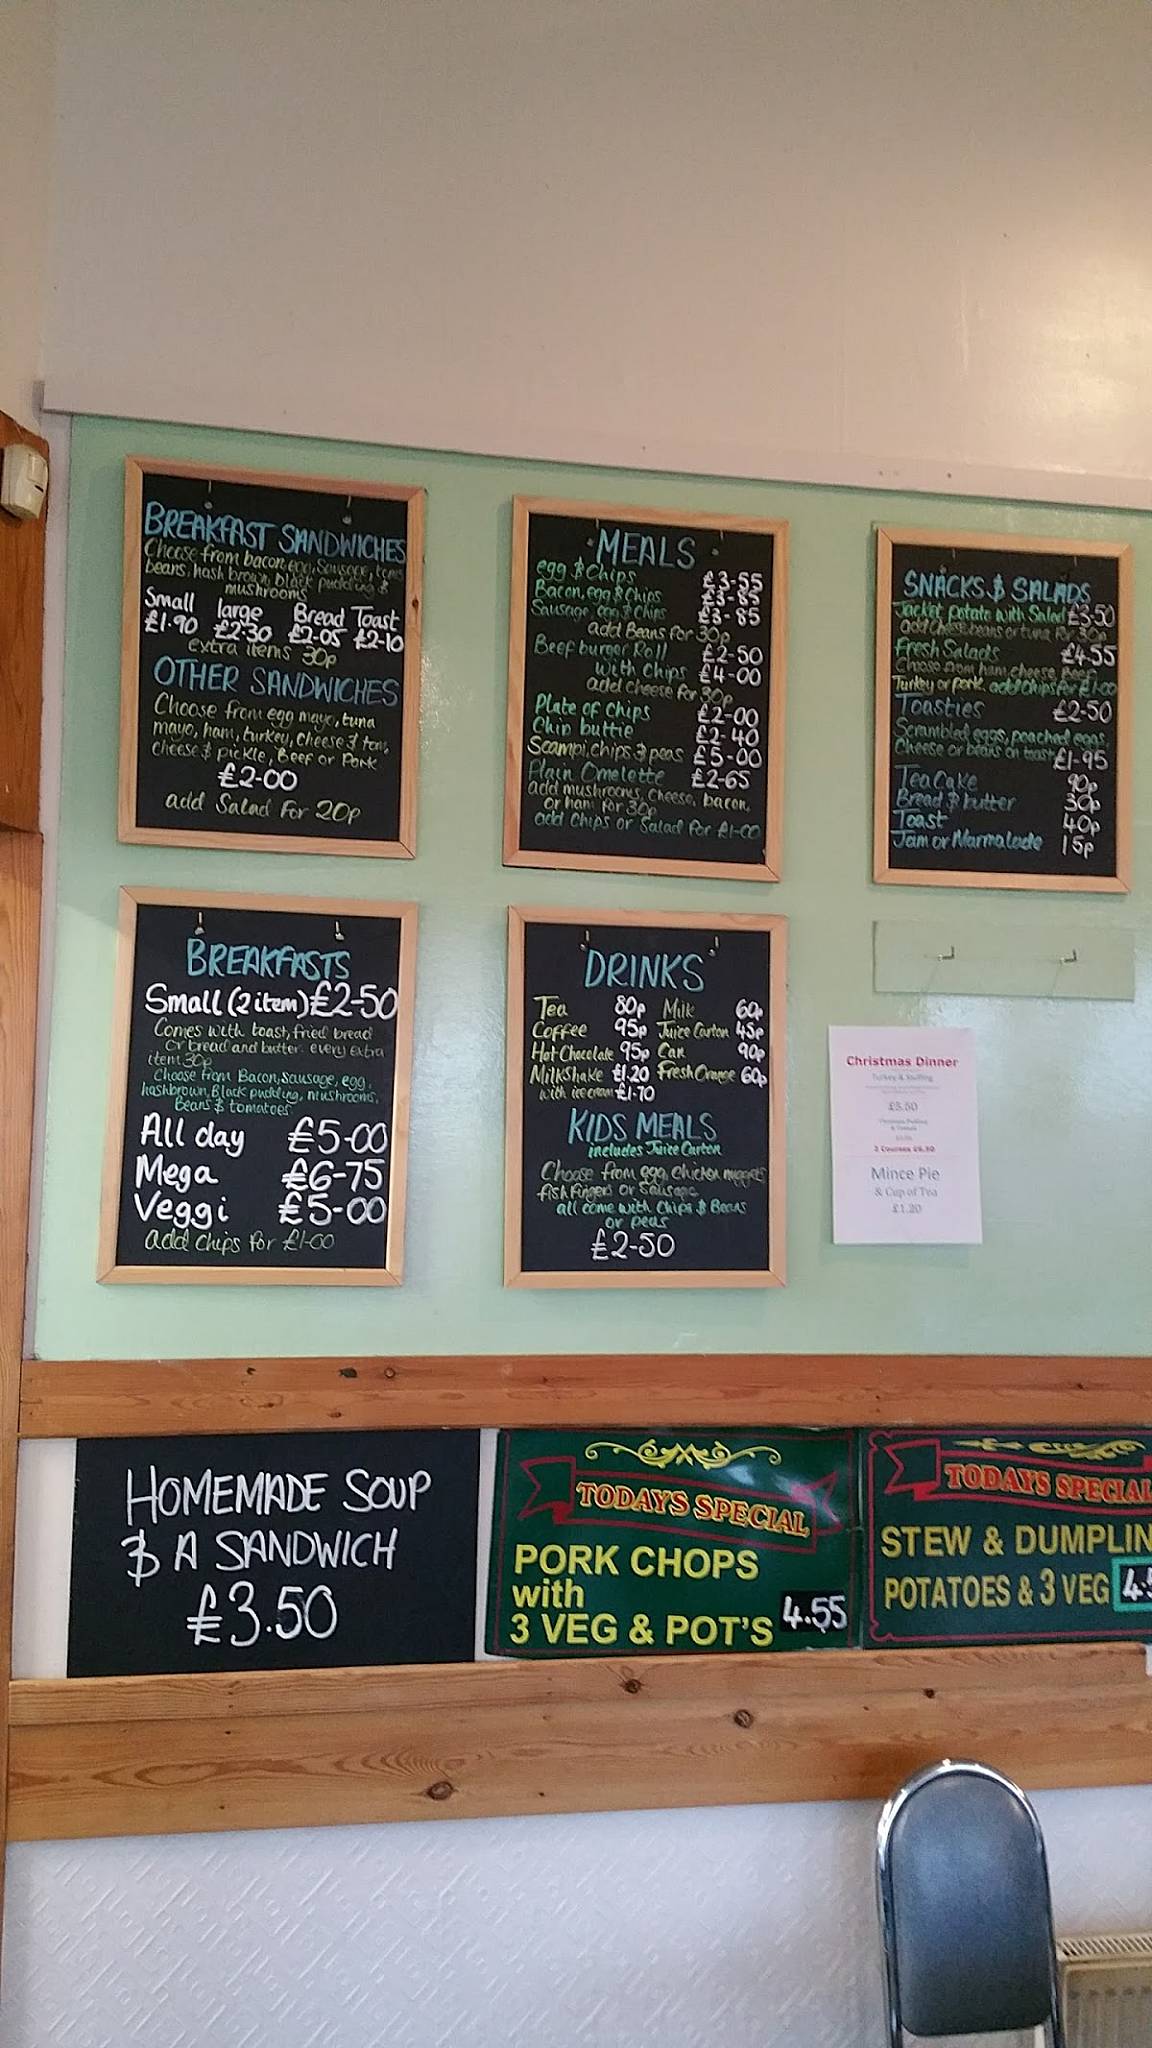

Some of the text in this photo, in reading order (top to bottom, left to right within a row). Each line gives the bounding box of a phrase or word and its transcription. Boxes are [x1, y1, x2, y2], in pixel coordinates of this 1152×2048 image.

[144, 501, 406, 563] BREAKFAST SANDWICHES
[200, 545, 240, 566] from
[596, 529, 696, 570] MEALS
[193, 563, 224, 580] hash
[225, 583, 307, 601] mushrooms
[903, 569, 1091, 605] SNACKS SALADS
[144, 586, 401, 631] Small large Bread Toast
[588, 622, 731, 645] add Beans 30p
[188, 639, 337, 668] extra items 30p
[633, 641, 764, 665] Roll £2-50
[943, 639, 1000, 662] Salads
[154, 655, 401, 706] OTHER SANDWICHES
[699, 666, 762, 687] £4-00
[586, 677, 733, 710] add 30p
[895, 692, 1112, 724] Toasties £2-50
[154, 691, 294, 728] Choose from egg
[535, 693, 760, 727] Plate of £2-00
[532, 716, 634, 739] Chip buttie
[318, 753, 335, 765] or
[650, 745, 763, 769] peas £5-00
[1053, 747, 1109, 771] £1-95
[217, 762, 298, 791] £2-00
[528, 761, 750, 790] Plain £2-65
[528, 780, 560, 796] add
[1068, 773, 1098, 795] 90p
[165, 792, 361, 825] add Salad 20p
[896, 787, 1101, 814] Bread 30p
[534, 812, 632, 829] add or
[893, 808, 1101, 836] Toast 40p
[891, 828, 1094, 859] Jam or Marmalade 15p
[187, 937, 351, 982] BREAKFASTS
[584, 949, 705, 993] DRINKS
[144, 980, 399, 1020] Small £2-50
[533, 995, 764, 1021] Tea 80p Milk 60p
[154, 1017, 373, 1041] Comes with fried bread
[532, 1018, 764, 1042] Coffee 95p Juice 45p
[148, 1051, 212, 1070] item 30p
[188, 1041, 385, 1059] bread and butter every extra
[531, 1041, 766, 1063] Hot Chocolate 95p Can 90p
[846, 1056, 958, 1068] Christmas Dinner
[154, 1068, 231, 1083] Choose from
[657, 1059, 768, 1088] Fresh Orange 60p
[140, 1112, 388, 1158] All day £5-00
[568, 1108, 719, 1144] KIDS MEALS
[588, 1139, 679, 1159] includes Juice
[135, 1153, 386, 1193] Mega £6-75
[540, 1159, 636, 1183] Choose from
[871, 1166, 940, 1181] Mince Pie
[619, 1187, 634, 1197] or
[874, 1187, 938, 1198] & Cup of Tea
[134, 1189, 387, 1230] Veggi £5-00
[556, 1199, 650, 1217] all come with
[892, 1203, 922, 1214] £1.20
[605, 1216, 669, 1230] or peas
[144, 1228, 190, 1251] add
[591, 1228, 676, 1261] £2-50
[944, 1463, 1050, 1496] TODAYS
[127, 1464, 432, 1526] HOMEMADE SOUP
[576, 1481, 812, 1539] TODAYS SPECIAL
[173, 1528, 398, 1573] A SANDWICH
[881, 1525, 972, 1559] STEW
[983, 1526, 1004, 1556] &
[514, 1543, 760, 1581] PORK CHOPS
[512, 1578, 585, 1609] with
[884, 1567, 1110, 1610] POTATOES & 3 VEG
[186, 1579, 338, 1647] £3.50
[781, 1595, 848, 1635] 4.55
[510, 1613, 775, 1647] 3 VEG & POT'S
